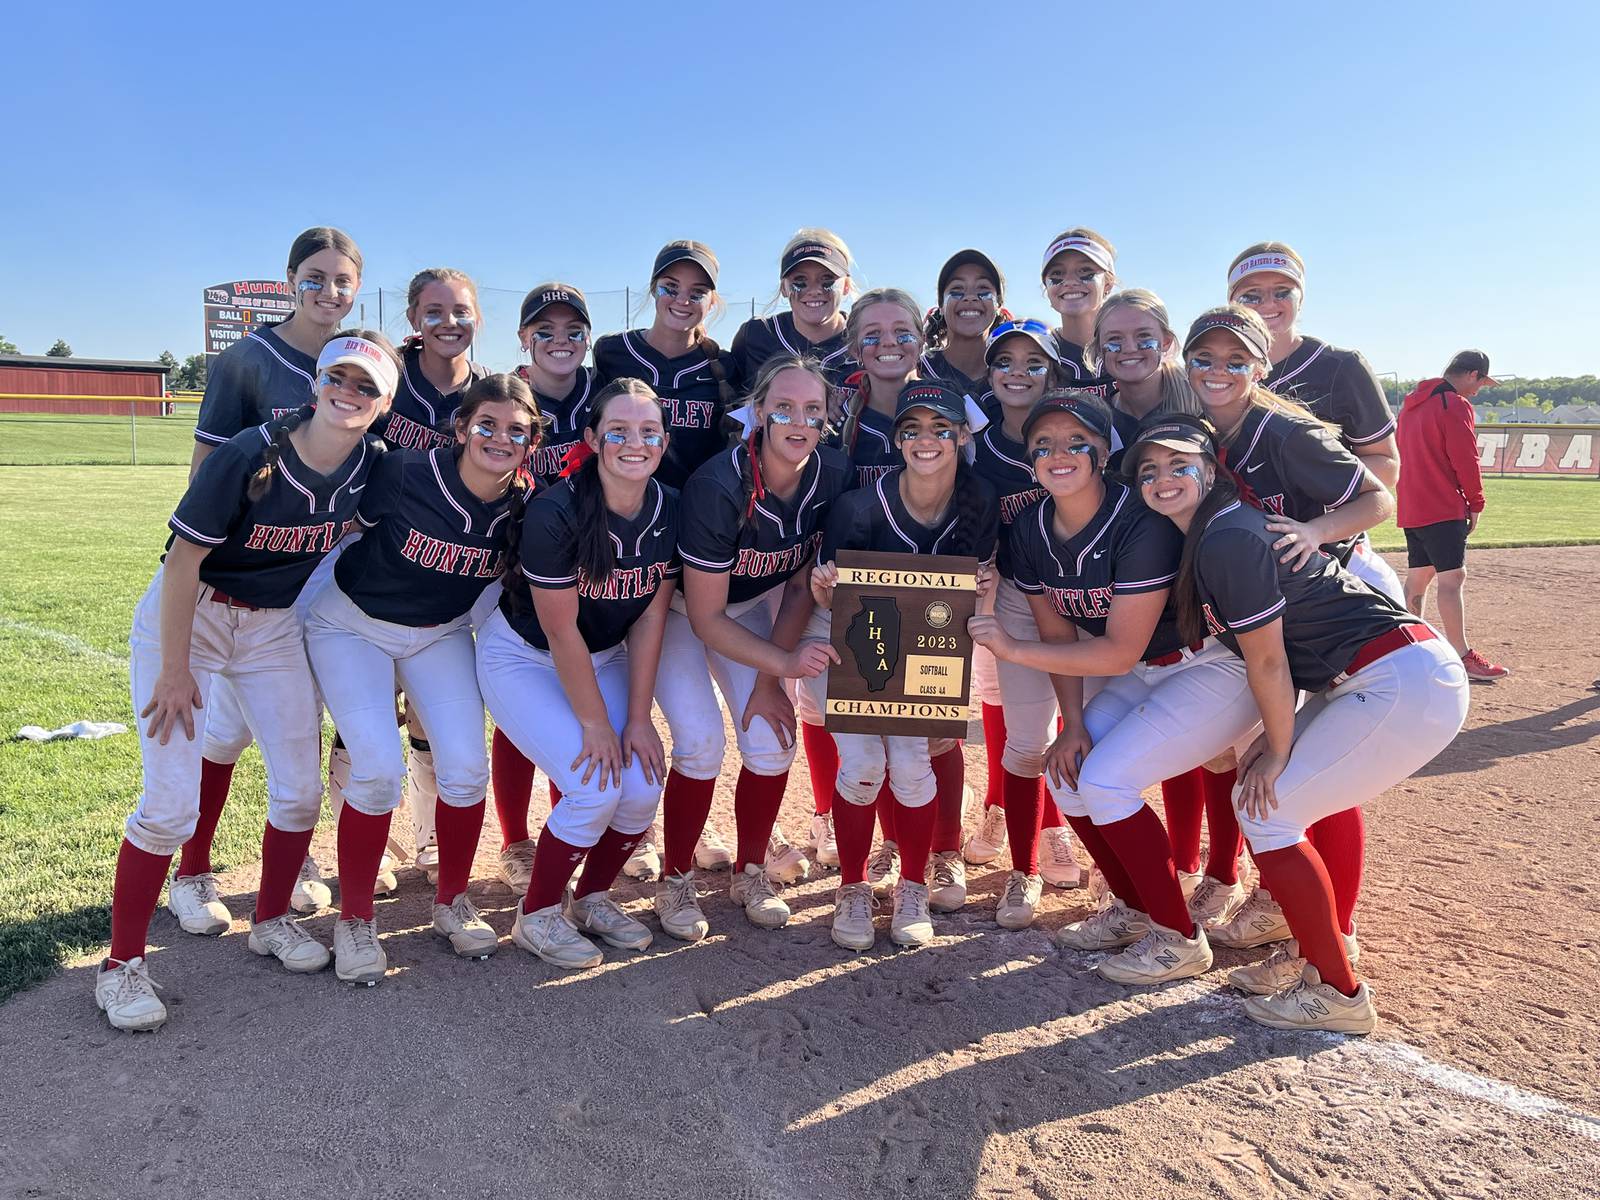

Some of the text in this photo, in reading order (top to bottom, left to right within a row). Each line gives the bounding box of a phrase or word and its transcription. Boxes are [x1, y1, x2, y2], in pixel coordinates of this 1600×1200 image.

[542, 291, 570, 302] HHS
[219, 310, 243, 321] BALL
[209, 329, 242, 339] VISITOR
[850, 570, 961, 588] REGIONAL
[917, 635, 957, 650] 2023
[919, 664, 948, 677] SOFTBALL
[919, 685, 937, 696] CLASS
[833, 701, 960, 718] CHAMPIONS
